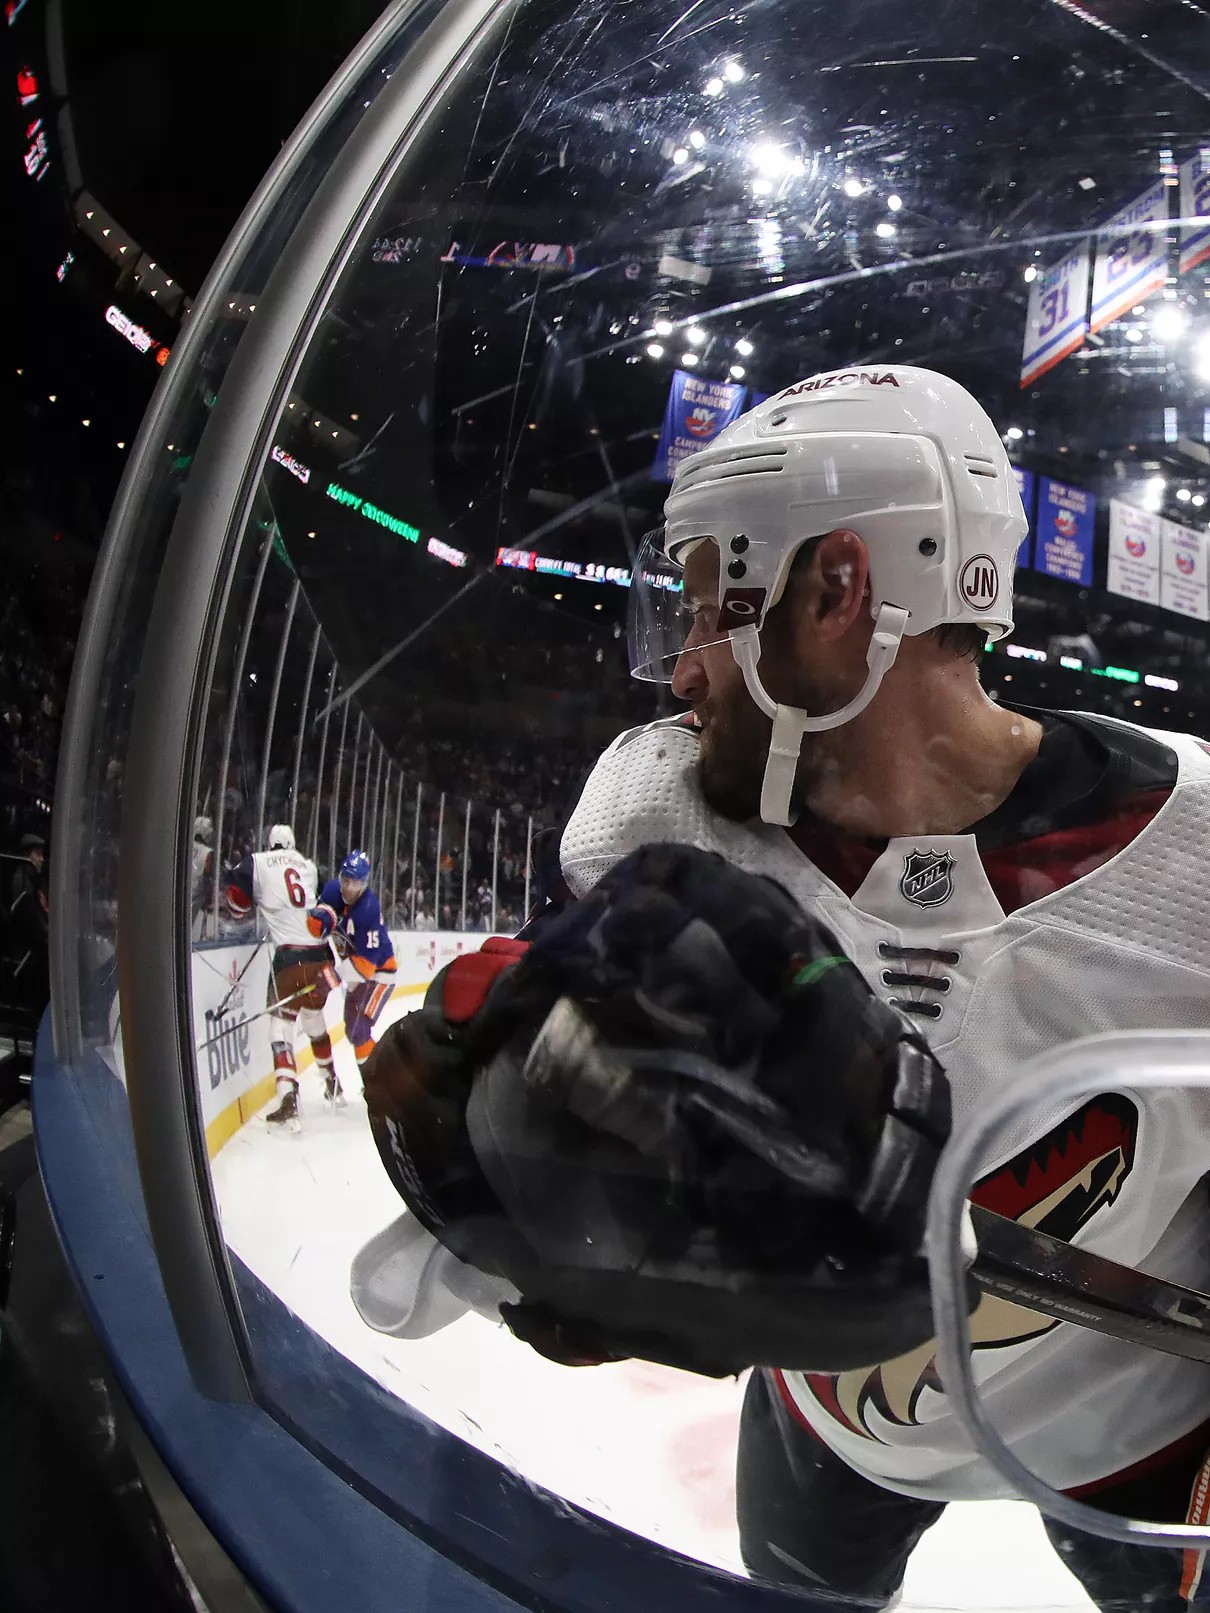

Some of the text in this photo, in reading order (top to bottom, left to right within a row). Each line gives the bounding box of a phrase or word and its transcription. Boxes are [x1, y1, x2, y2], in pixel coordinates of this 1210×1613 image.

[1038, 281, 1070, 338] 31
[777, 372, 900, 401] ARIZONA
[966, 566, 994, 598] JN
[284, 867, 306, 909] 6
[911, 865, 945, 893] NHL
[366, 930, 380, 950] 15
